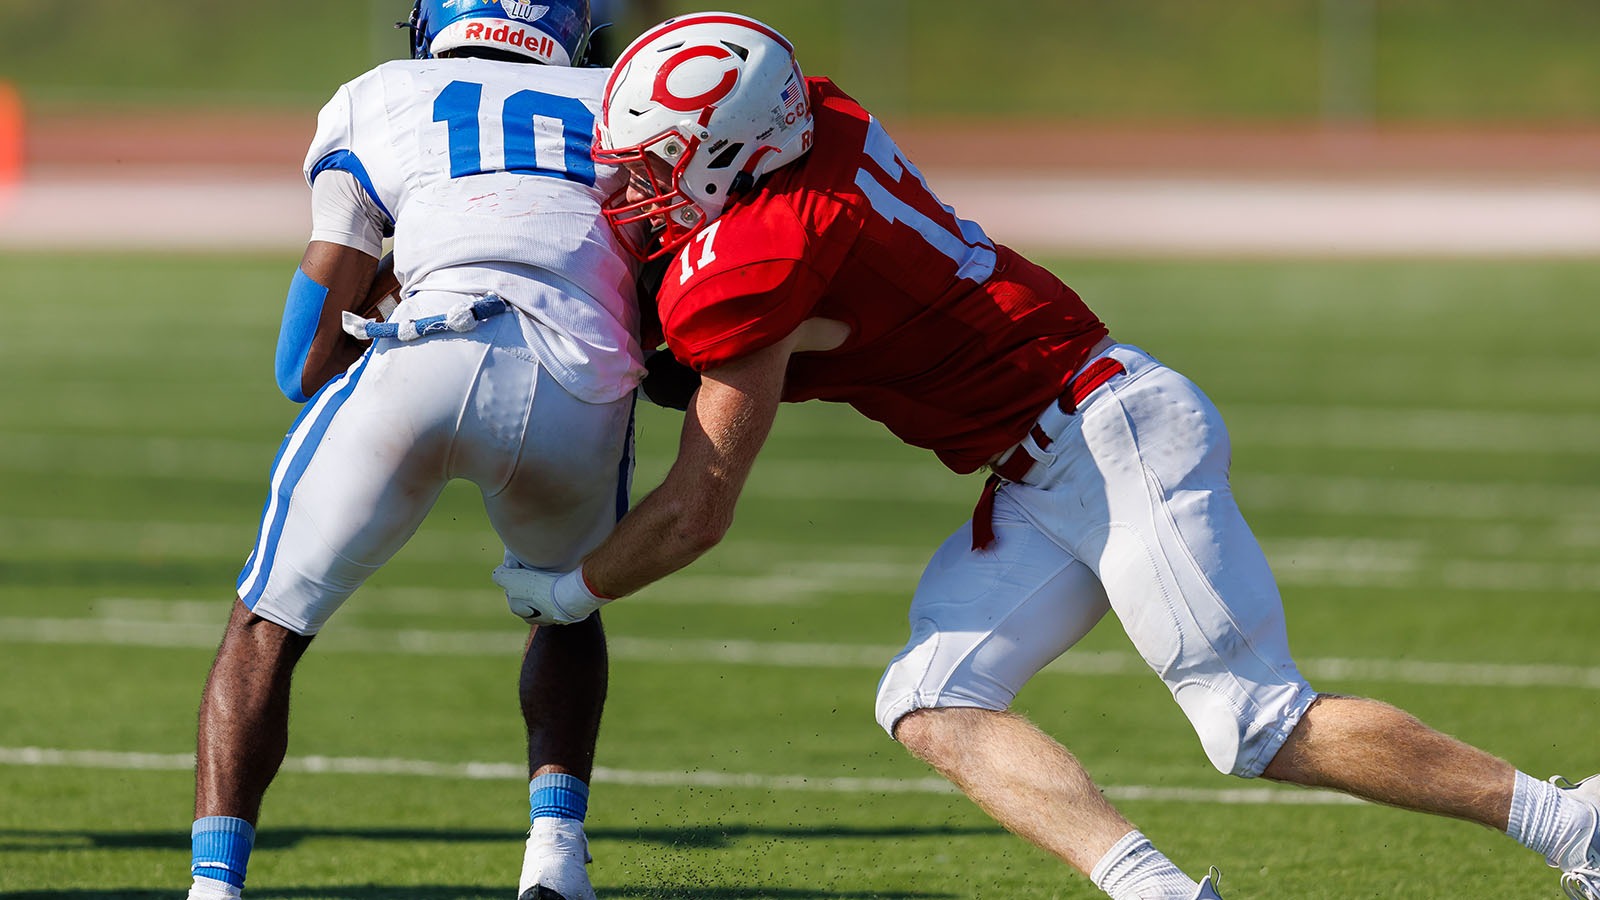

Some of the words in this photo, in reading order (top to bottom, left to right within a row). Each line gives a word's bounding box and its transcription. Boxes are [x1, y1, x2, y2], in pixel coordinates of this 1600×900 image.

[465, 22, 554, 57] Riddell
[511, 4, 533, 19] LLU
[650, 45, 738, 112] C
[433, 80, 595, 187] 10
[854, 113, 997, 285] 17
[679, 219, 722, 286] 17
